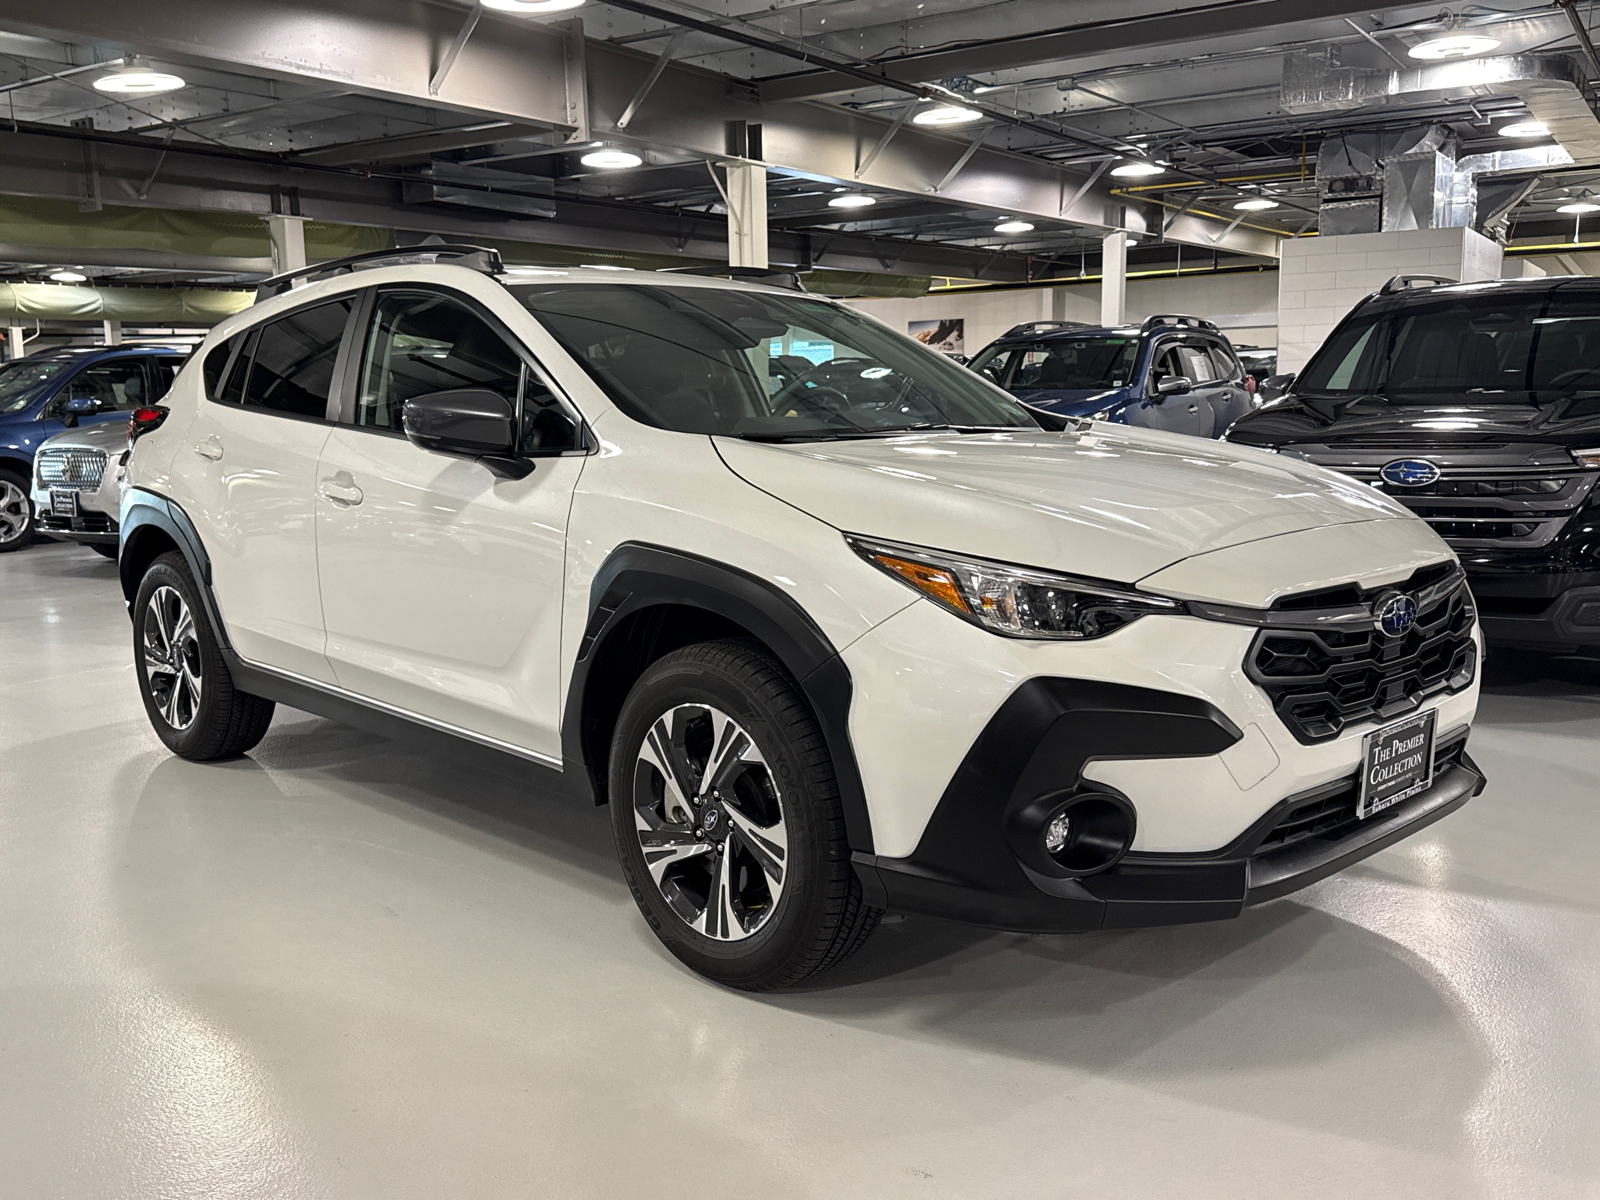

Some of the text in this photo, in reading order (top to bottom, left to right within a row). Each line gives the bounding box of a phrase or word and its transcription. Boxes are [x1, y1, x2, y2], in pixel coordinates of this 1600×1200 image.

[1373, 733, 1425, 765] THE PREMIER
[1370, 751, 1423, 785] COLLECTION
[774, 750, 807, 868] YOKOHA
